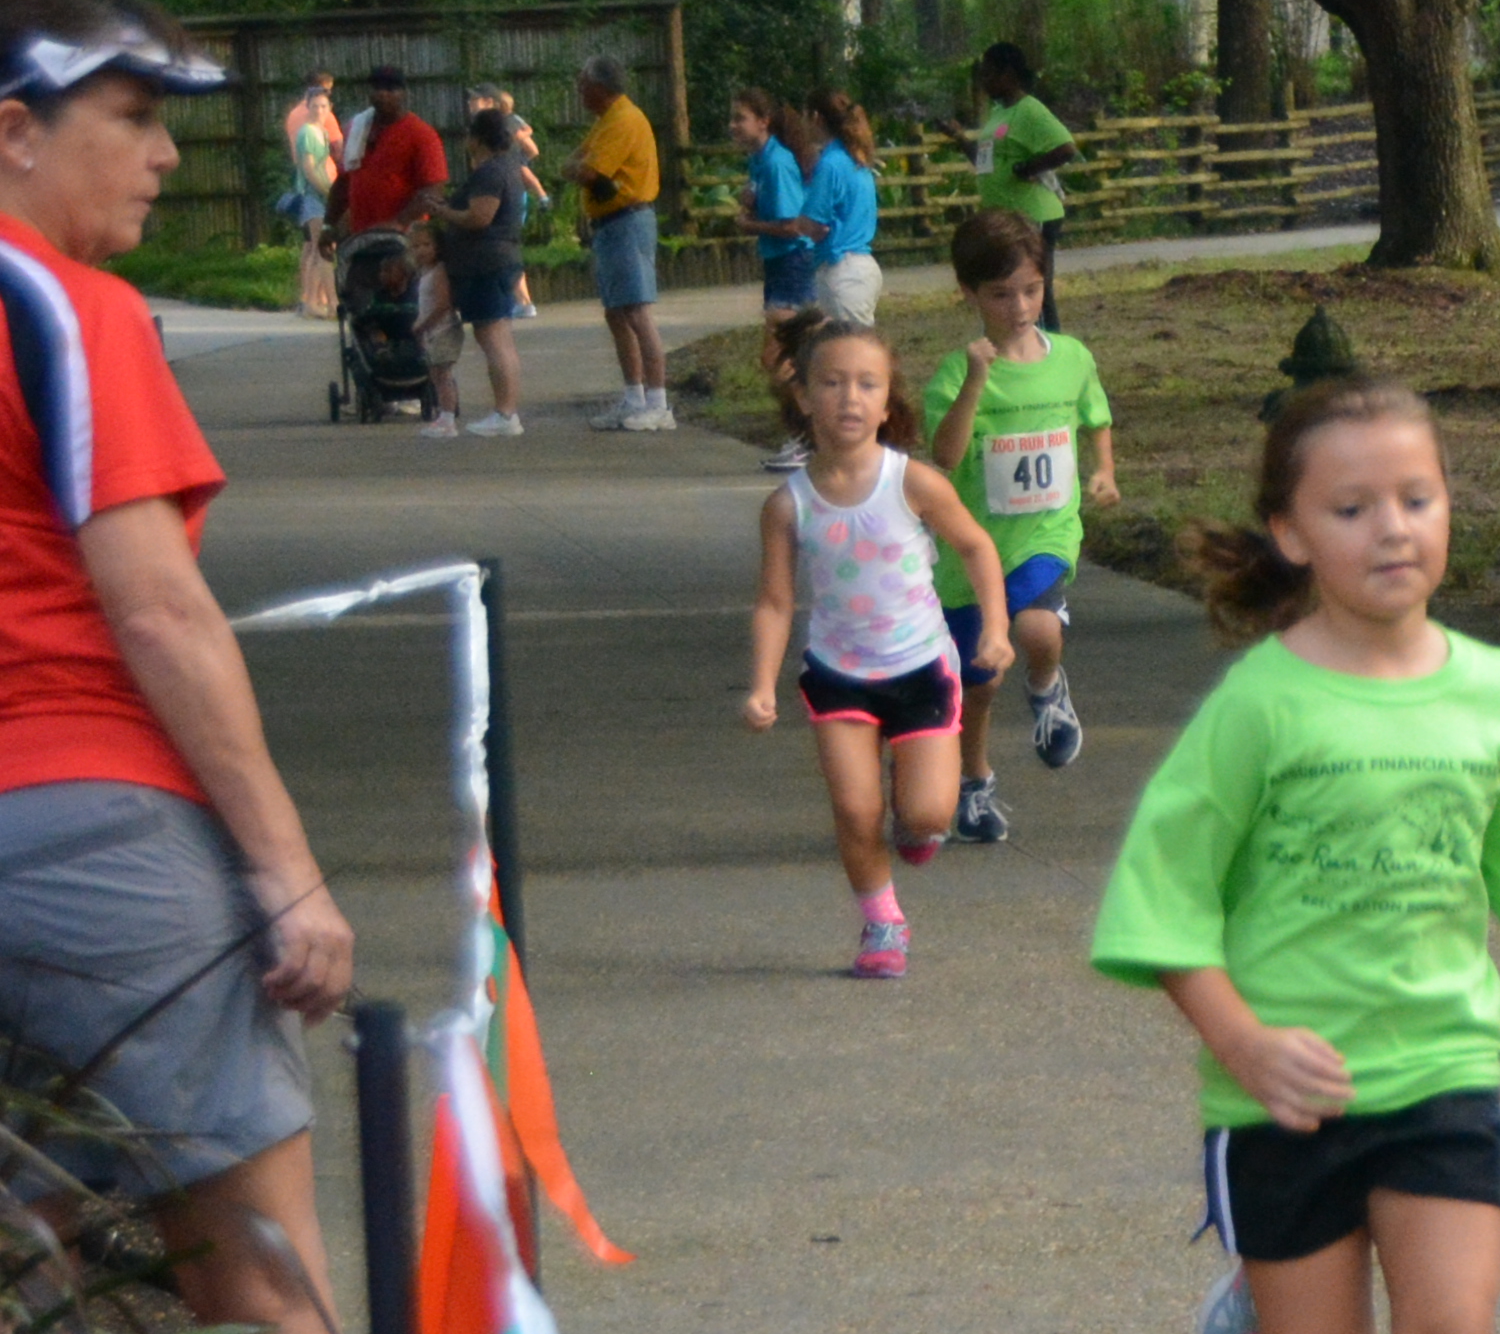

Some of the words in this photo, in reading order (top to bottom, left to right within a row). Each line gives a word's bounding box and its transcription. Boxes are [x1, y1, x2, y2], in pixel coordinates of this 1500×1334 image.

[991, 438, 1015, 453] ZOO
[1020, 436, 1045, 451] RUN
[1048, 431, 1069, 447] RUN
[1014, 453, 1053, 491] 40
[1370, 756, 1458, 772] FINANCIAL
[1311, 843, 1358, 871] Run
[1372, 847, 1418, 876] Run
